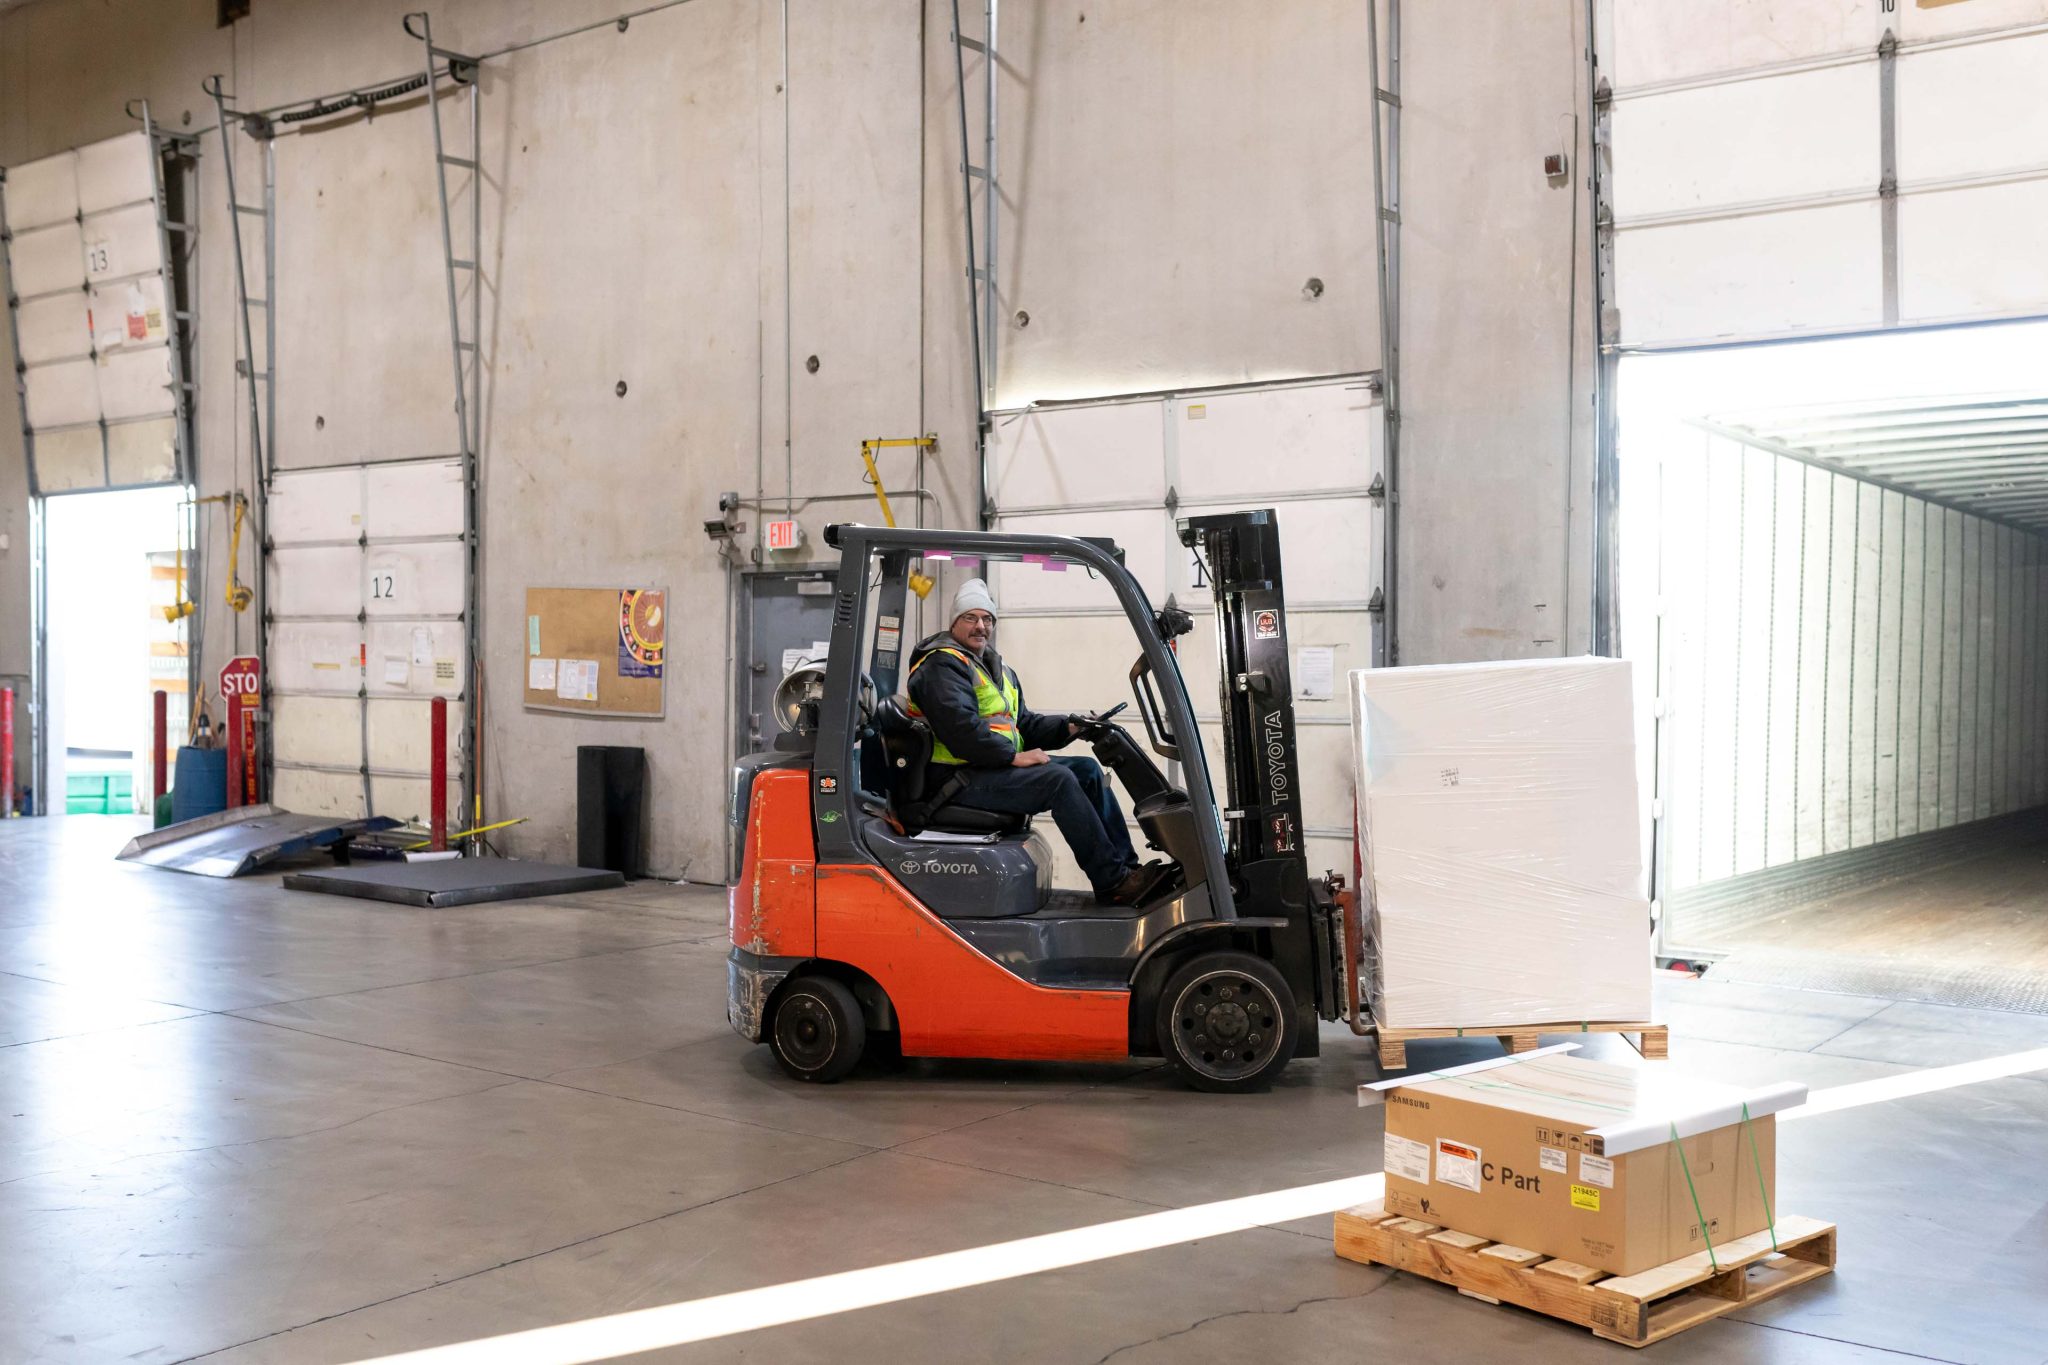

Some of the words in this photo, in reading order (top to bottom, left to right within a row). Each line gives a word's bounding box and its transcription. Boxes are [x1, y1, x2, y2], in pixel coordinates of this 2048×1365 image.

[89, 249, 109, 272] 13
[770, 521, 793, 547] EXIT
[372, 577, 394, 598] 12
[223, 672, 259, 694] STO
[1265, 710, 1289, 805] TOYOTA
[820, 777, 837, 788] SAS
[922, 862, 979, 875] TOYOTA
[1392, 1095, 1430, 1110] SAMSUNG
[1501, 1166, 1541, 1194] Part
